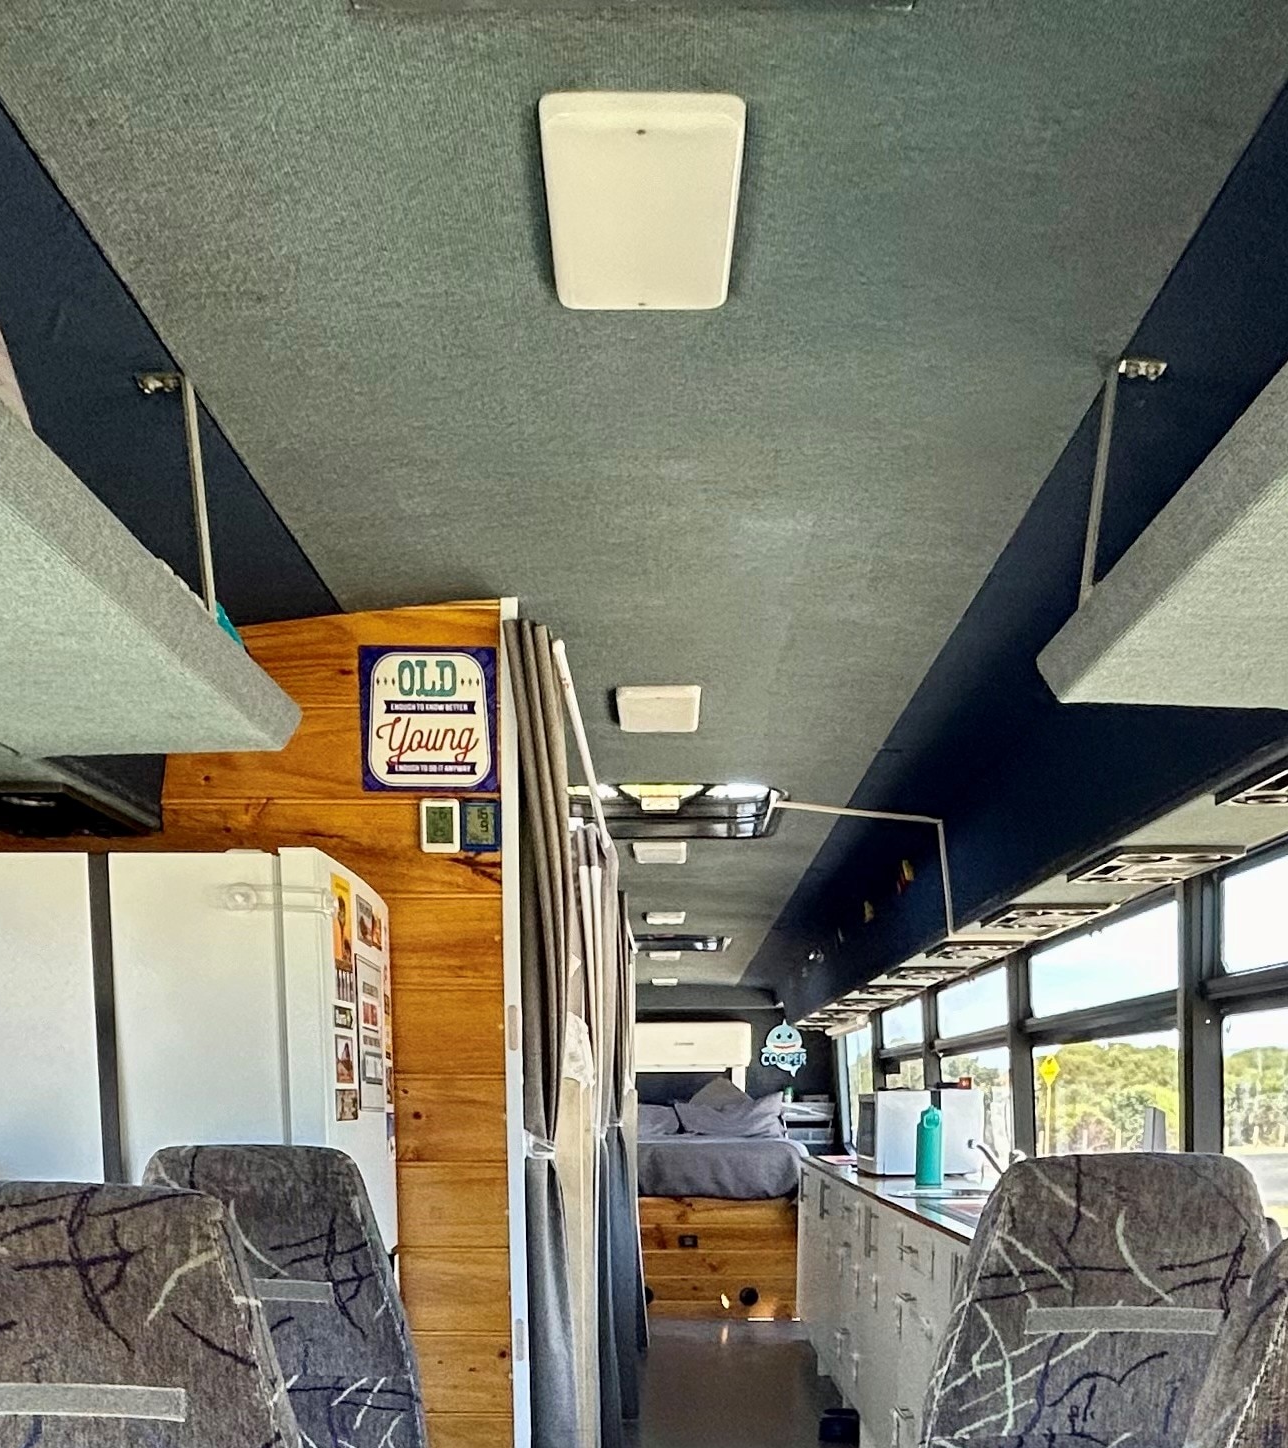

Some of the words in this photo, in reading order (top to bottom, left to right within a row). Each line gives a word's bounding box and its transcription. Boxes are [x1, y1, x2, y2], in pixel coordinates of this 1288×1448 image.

[397, 659, 457, 697] OLD
[376, 716, 480, 764] Young
[760, 1052, 808, 1067] COOPER
